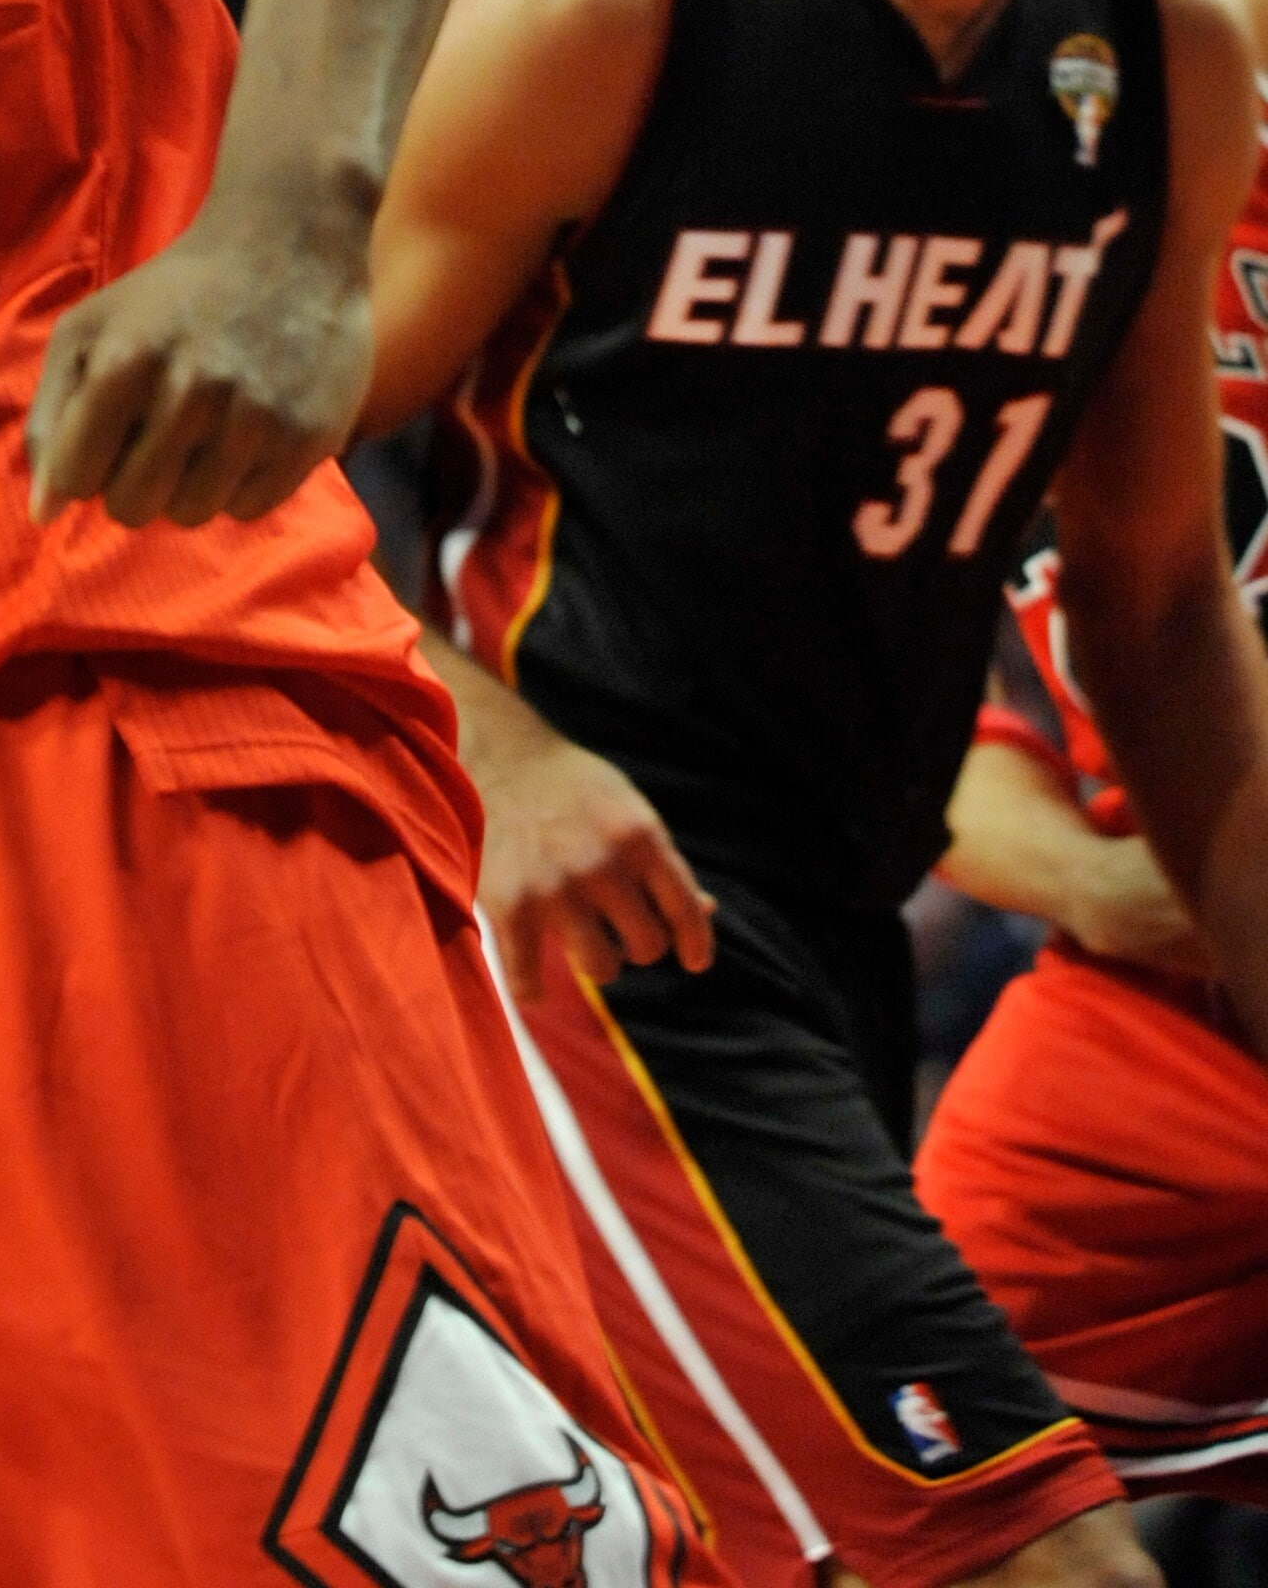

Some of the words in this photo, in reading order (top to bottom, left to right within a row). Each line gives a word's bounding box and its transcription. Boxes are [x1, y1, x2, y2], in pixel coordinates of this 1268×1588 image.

[645, 229, 805, 347] EL
[818, 210, 1129, 359] HEAT
[851, 385, 1054, 561] 31
